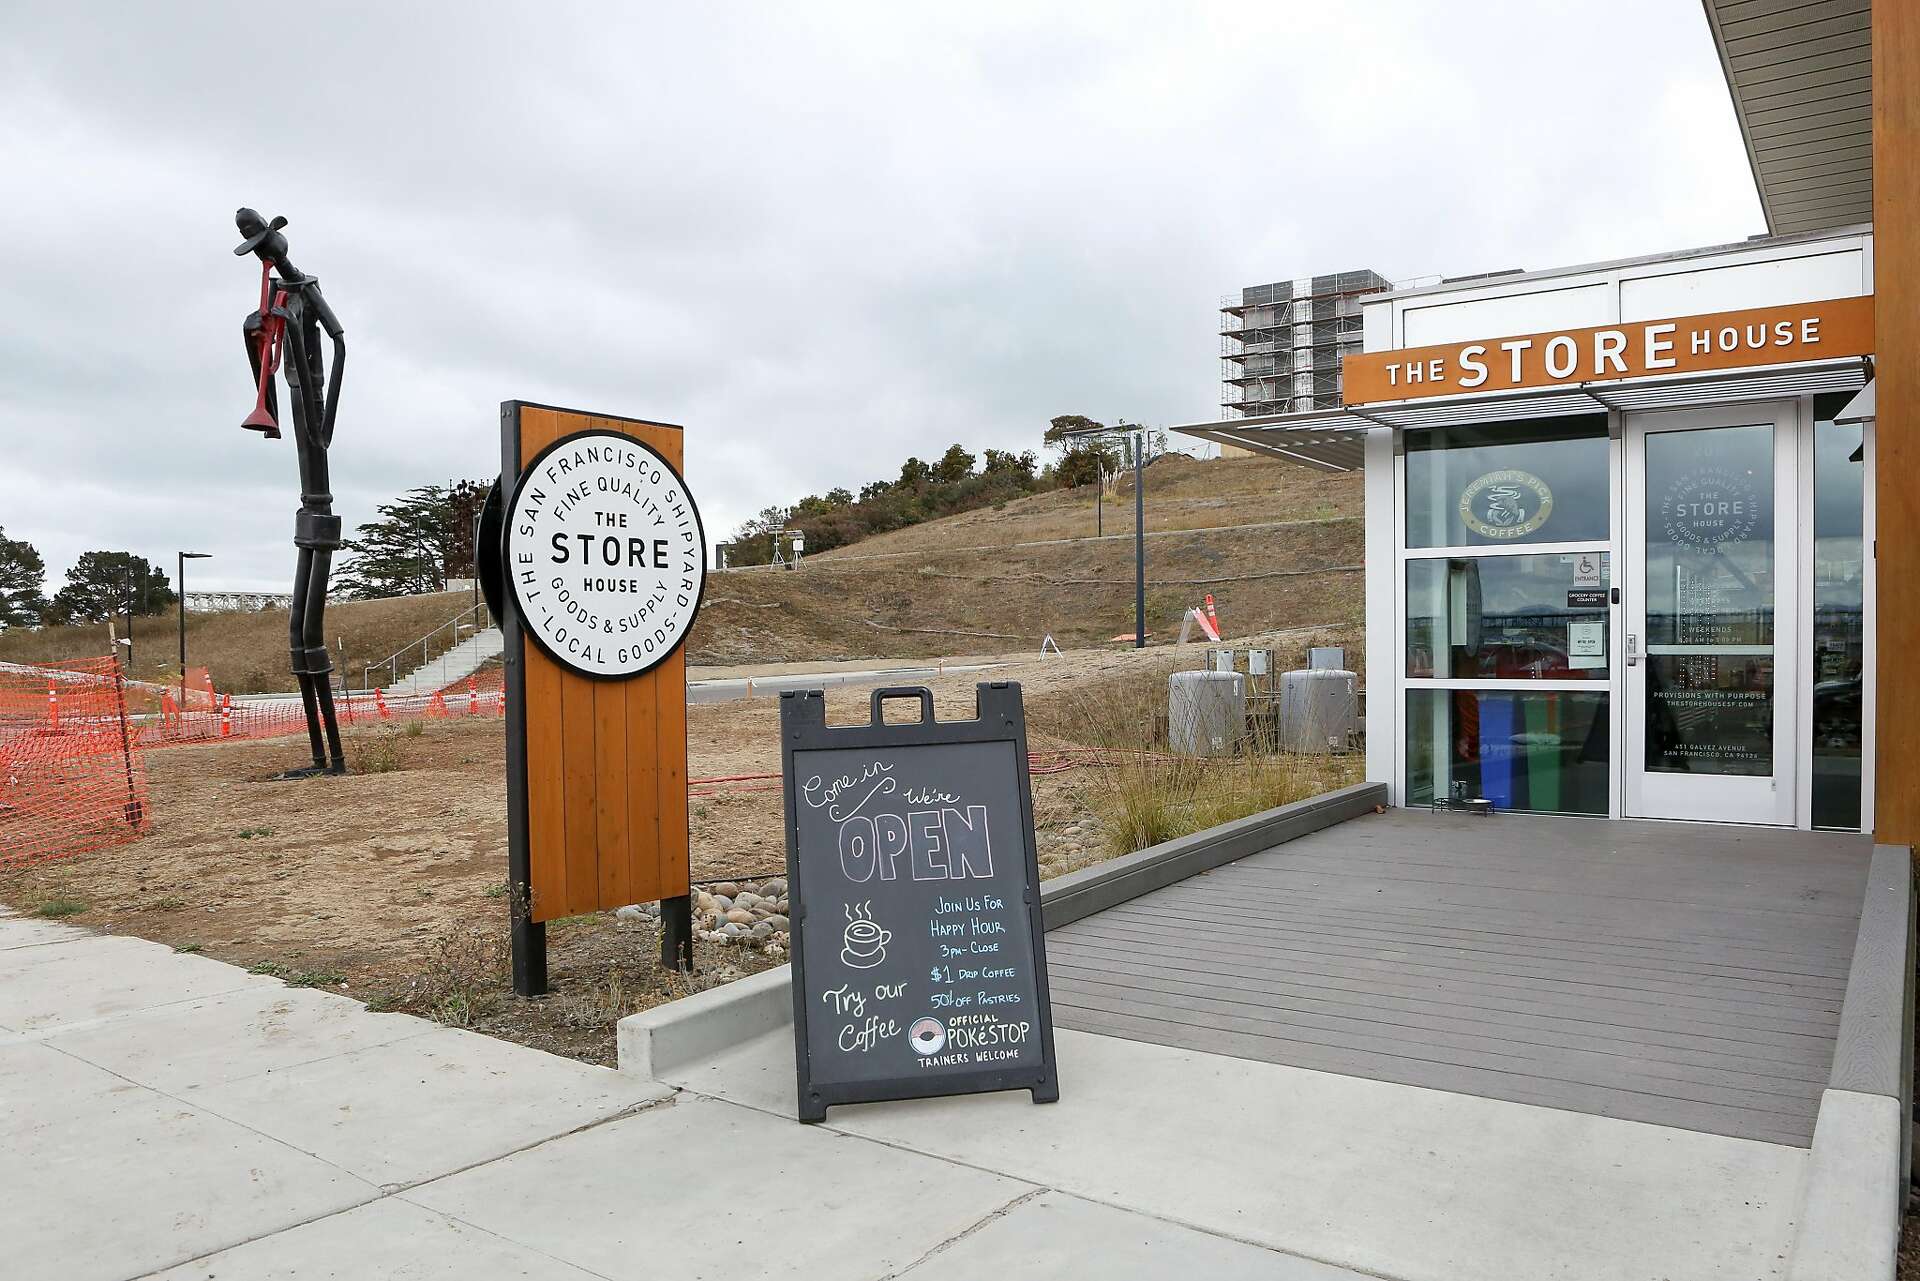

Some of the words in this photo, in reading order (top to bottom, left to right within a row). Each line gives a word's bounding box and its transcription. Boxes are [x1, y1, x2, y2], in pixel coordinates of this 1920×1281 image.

[1385, 358, 1445, 386] THE
[1458, 322, 1677, 388] STORE
[1690, 317, 1821, 355] HOUSE
[546, 446, 662, 485] FRANCISCO
[520, 487, 547, 538] SAN
[553, 480, 592, 522] FINE
[597, 476, 665, 527] QUALITY
[1676, 501, 1744, 517] STORE
[1700, 491, 1720, 500] THE
[594, 511, 628, 528] THE
[1480, 522, 1532, 537] COFFEE
[1676, 521, 1703, 544] GOODS
[1712, 519, 1743, 544] SUPPLY
[1693, 519, 1724, 528] HOUSE
[550, 532, 669, 569] STORE
[664, 489, 696, 608] SHIPYARD
[518, 552, 541, 603] THE
[583, 577, 638, 594] HOUSE
[551, 577, 598, 631] GOODS
[603, 619, 614, 634] &
[618, 580, 668, 634] SUPPLY
[543, 615, 606, 665] LOCAL
[618, 619, 676, 664] GOODS
[1653, 691, 1701, 699] PROVISIONS
[801, 775, 858, 808] Come
[860, 761, 895, 783] in
[903, 787, 961, 805] We're
[838, 805, 994, 883] OPEN
[930, 964, 955, 984] $1
[822, 983, 867, 1018] Try
[875, 982, 908, 1000] our
[838, 1014, 902, 1053] Coffee
[949, 1013, 999, 1028] OFFICIAL
[917, 1053, 970, 1069] TRAINERS
[976, 1048, 1020, 1063] WELCOME
